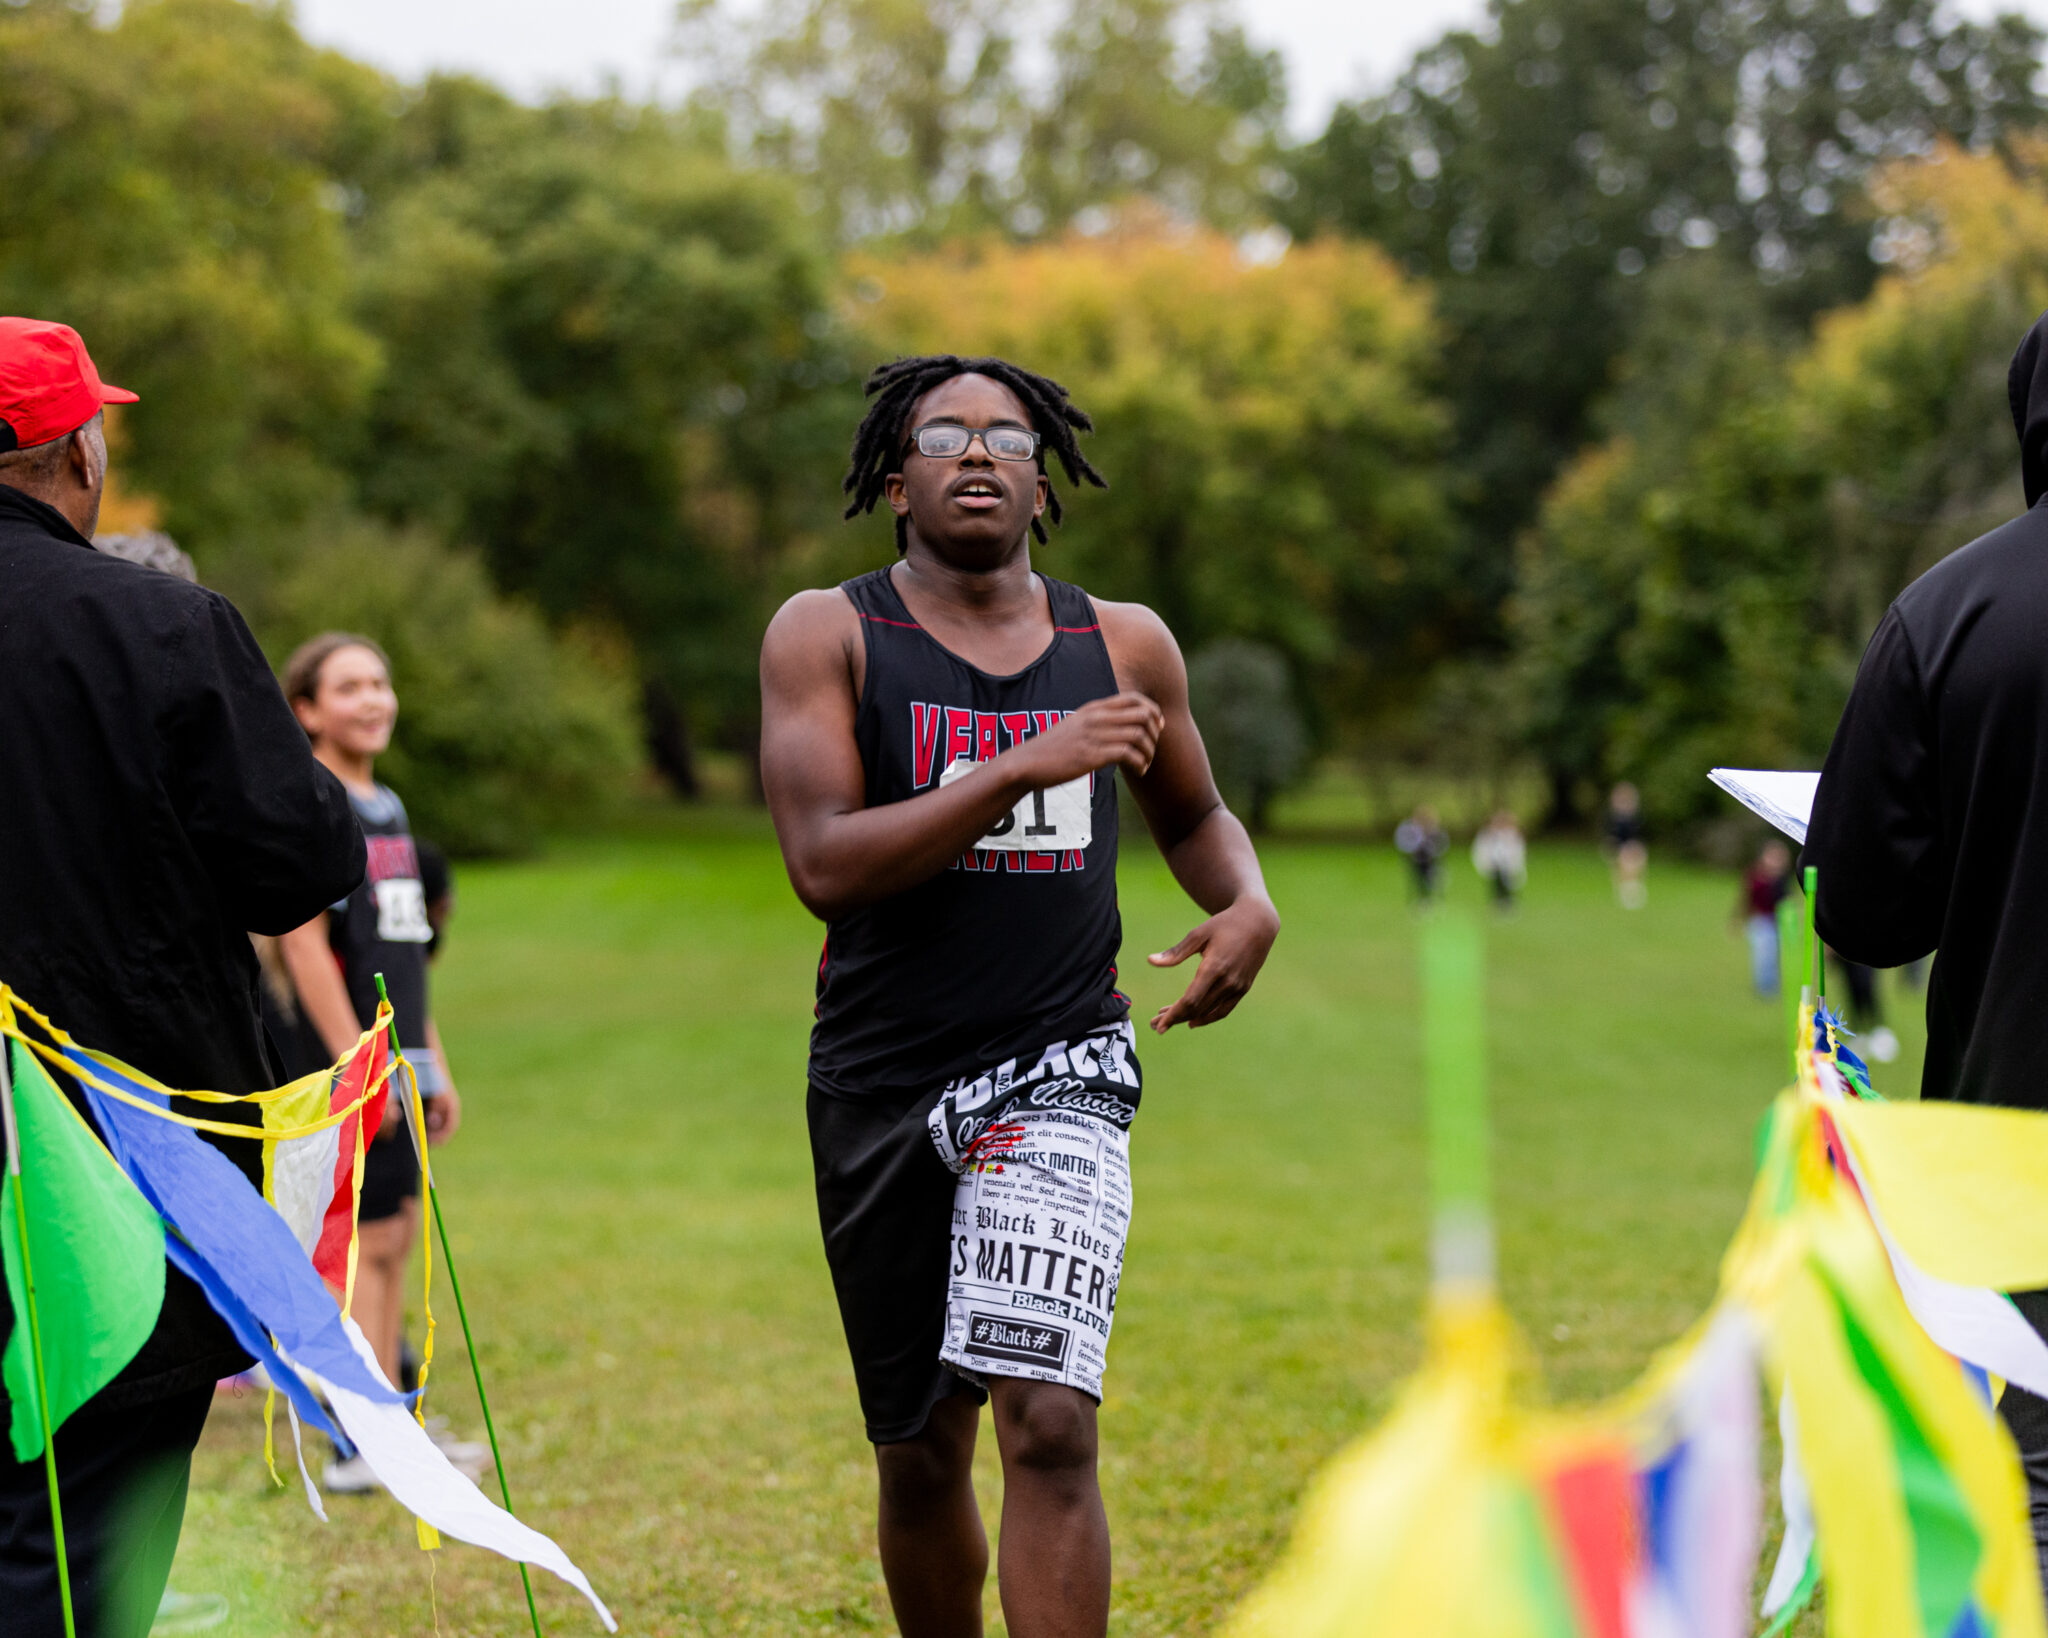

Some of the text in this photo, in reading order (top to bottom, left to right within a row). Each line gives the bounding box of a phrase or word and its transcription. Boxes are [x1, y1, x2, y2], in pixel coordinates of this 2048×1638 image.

[1030, 1078, 1138, 1125] Matter
[1037, 1129, 1052, 1138] elit
[1048, 1152, 1097, 1179] MATTER
[1014, 1194, 1041, 1205] neque
[1038, 1185, 1056, 1197] Sed
[976, 1205, 1036, 1235] Black
[1049, 1217, 1110, 1260] Lives
[976, 1238, 1106, 1310] MATTER
[1013, 1292, 1109, 1338] Black LIVES
[974, 1320, 1052, 1350] #Black#
[1030, 1369, 1058, 1381] augue
